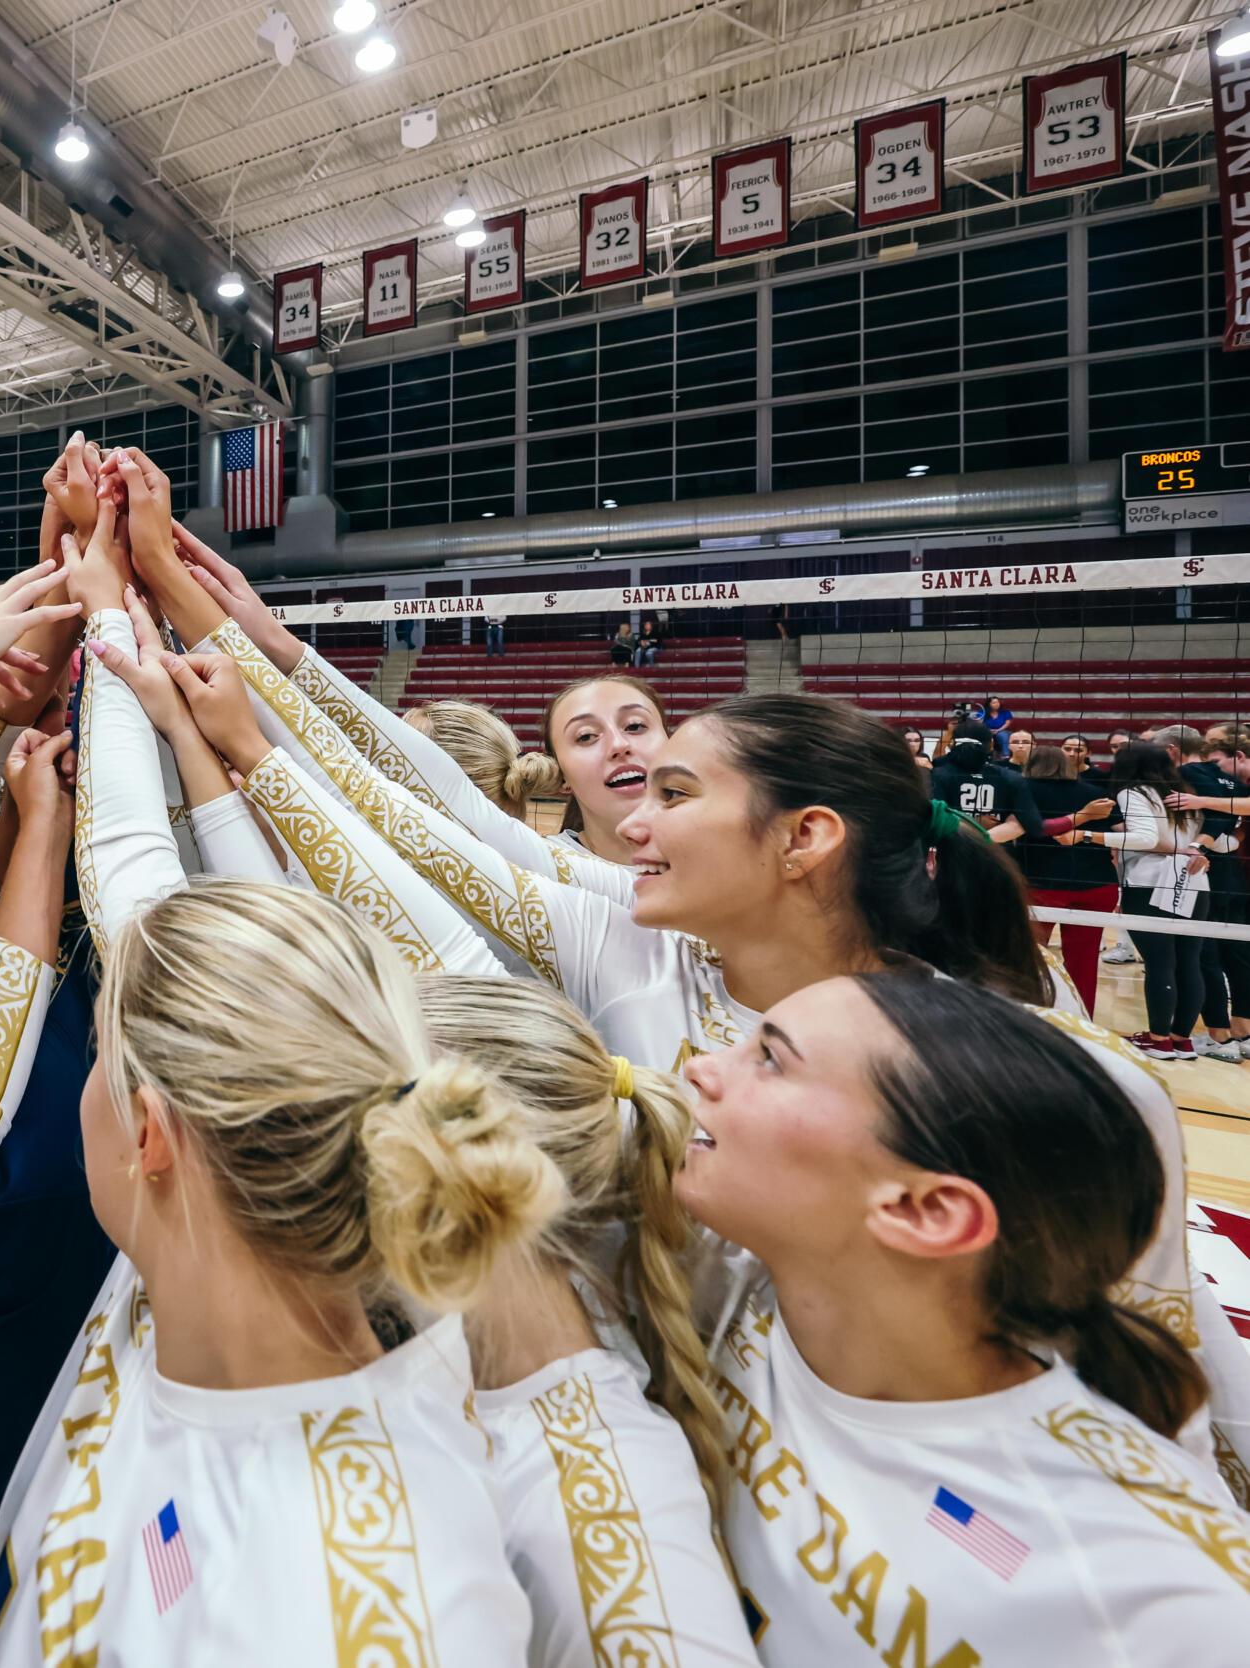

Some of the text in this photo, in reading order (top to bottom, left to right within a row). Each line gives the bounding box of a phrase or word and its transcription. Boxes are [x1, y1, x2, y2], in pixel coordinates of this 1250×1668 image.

[1047, 95, 1101, 116] AWTREY
[1047, 115, 1100, 145] 53
[878, 138, 922, 156] OGDEN
[1043, 146, 1106, 167] 1967-1970
[877, 156, 922, 184] 34
[731, 174, 771, 191] FEERICK
[742, 193, 760, 214] 5
[872, 185, 927, 205] 1966-1969
[597, 211, 630, 226] VANOS
[727, 218, 775, 236] 1938-1941
[480, 242, 510, 256] SEARS
[595, 227, 630, 251] 32
[379, 269, 401, 280] NASH
[479, 255, 510, 278] 55
[380, 283, 399, 302] 11
[285, 304, 310, 323] 34
[1141, 450, 1201, 466] BRONCOS
[1157, 469, 1195, 491] 25
[1128, 506, 1160, 516] one
[1129, 508, 1218, 524] workplace
[922, 565, 1077, 590] SANTA CLARA
[622, 583, 740, 604] SANTA CLARA
[394, 598, 485, 615] SANTA CLARA
[960, 783, 995, 812] 20
[796, 1490, 983, 1668] DAM
